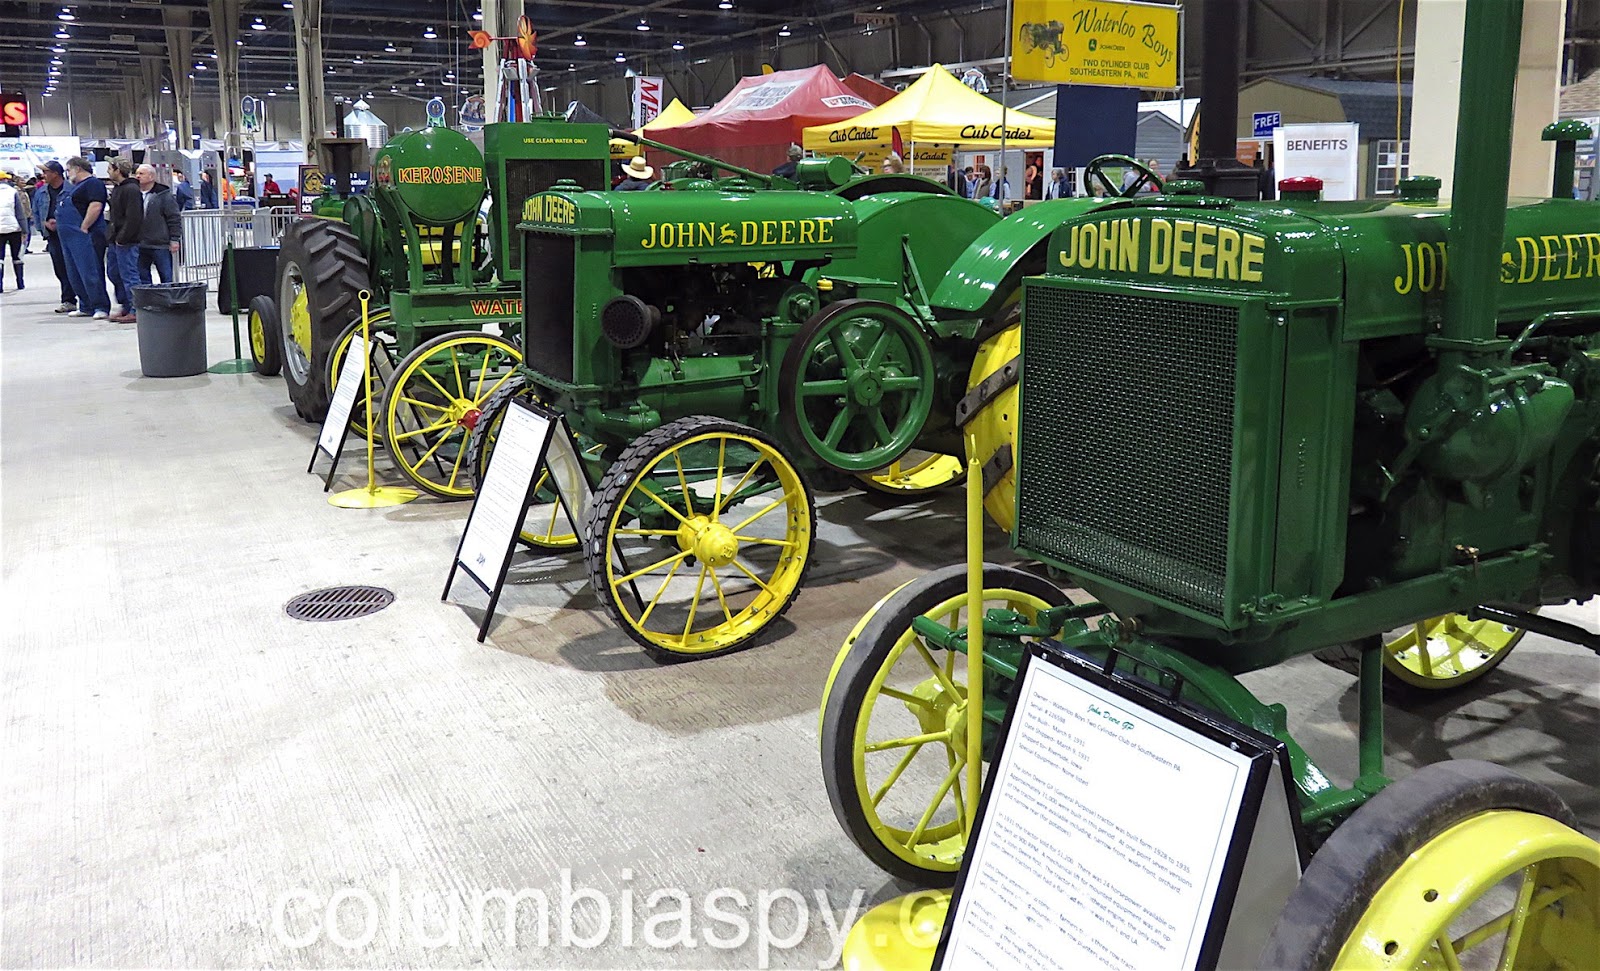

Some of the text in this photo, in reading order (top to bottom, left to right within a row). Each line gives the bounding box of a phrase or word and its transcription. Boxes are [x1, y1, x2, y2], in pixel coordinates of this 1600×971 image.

[1073, 8, 1174, 67] Waterloo Boys
[1070, 68, 1122, 77] SOUTHEASTERN
[1100, 60, 1131, 68] CYLINDER
[1134, 62, 1150, 70] CLUB
[829, 127, 878, 142] Cub Cadet
[960, 125, 988, 139] Cub
[1254, 114, 1279, 130] FREE
[920, 152, 948, 160] Cadet
[1287, 140, 1348, 150] BENEFITS
[398, 166, 482, 184] KEROSENE
[522, 195, 575, 224] JOHN DEERE
[642, 220, 835, 249] JOHN DEERE
[1060, 218, 1265, 282] JOHN DEERE
[1394, 242, 1448, 294] JO
[1052, 724, 1067, 737] March
[1087, 702, 1134, 734] John Deere GP
[1056, 738, 1072, 751] March
[1077, 750, 1090, 761] 1931
[1117, 734, 1130, 745] Club
[1137, 744, 1173, 767] Southeastern
[1061, 766, 1074, 778] None
[1096, 812, 1114, 827] tractor
[1115, 825, 1125, 834] was
[1125, 830, 1138, 842] built
[1153, 846, 1168, 860] 1928
[1093, 836, 1111, 850] narrow
[1127, 856, 1141, 869] wide
[1125, 843, 1136, 853] one
[1136, 848, 1151, 863] point
[1151, 859, 1168, 872] seven
[1168, 868, 1193, 888] versions
[1076, 862, 1091, 876] There
[1091, 873, 1102, 883] was
[1109, 884, 1142, 911] horsepower
[1142, 905, 1168, 926] available
[1088, 882, 1112, 902] mounted
[1112, 898, 1141, 923] equipment
[1142, 920, 1153, 930] was
[1119, 928, 1130, 940] and
[1127, 920, 1137, 931] the
[1137, 928, 1149, 941] only
[1150, 936, 1166, 951] other
